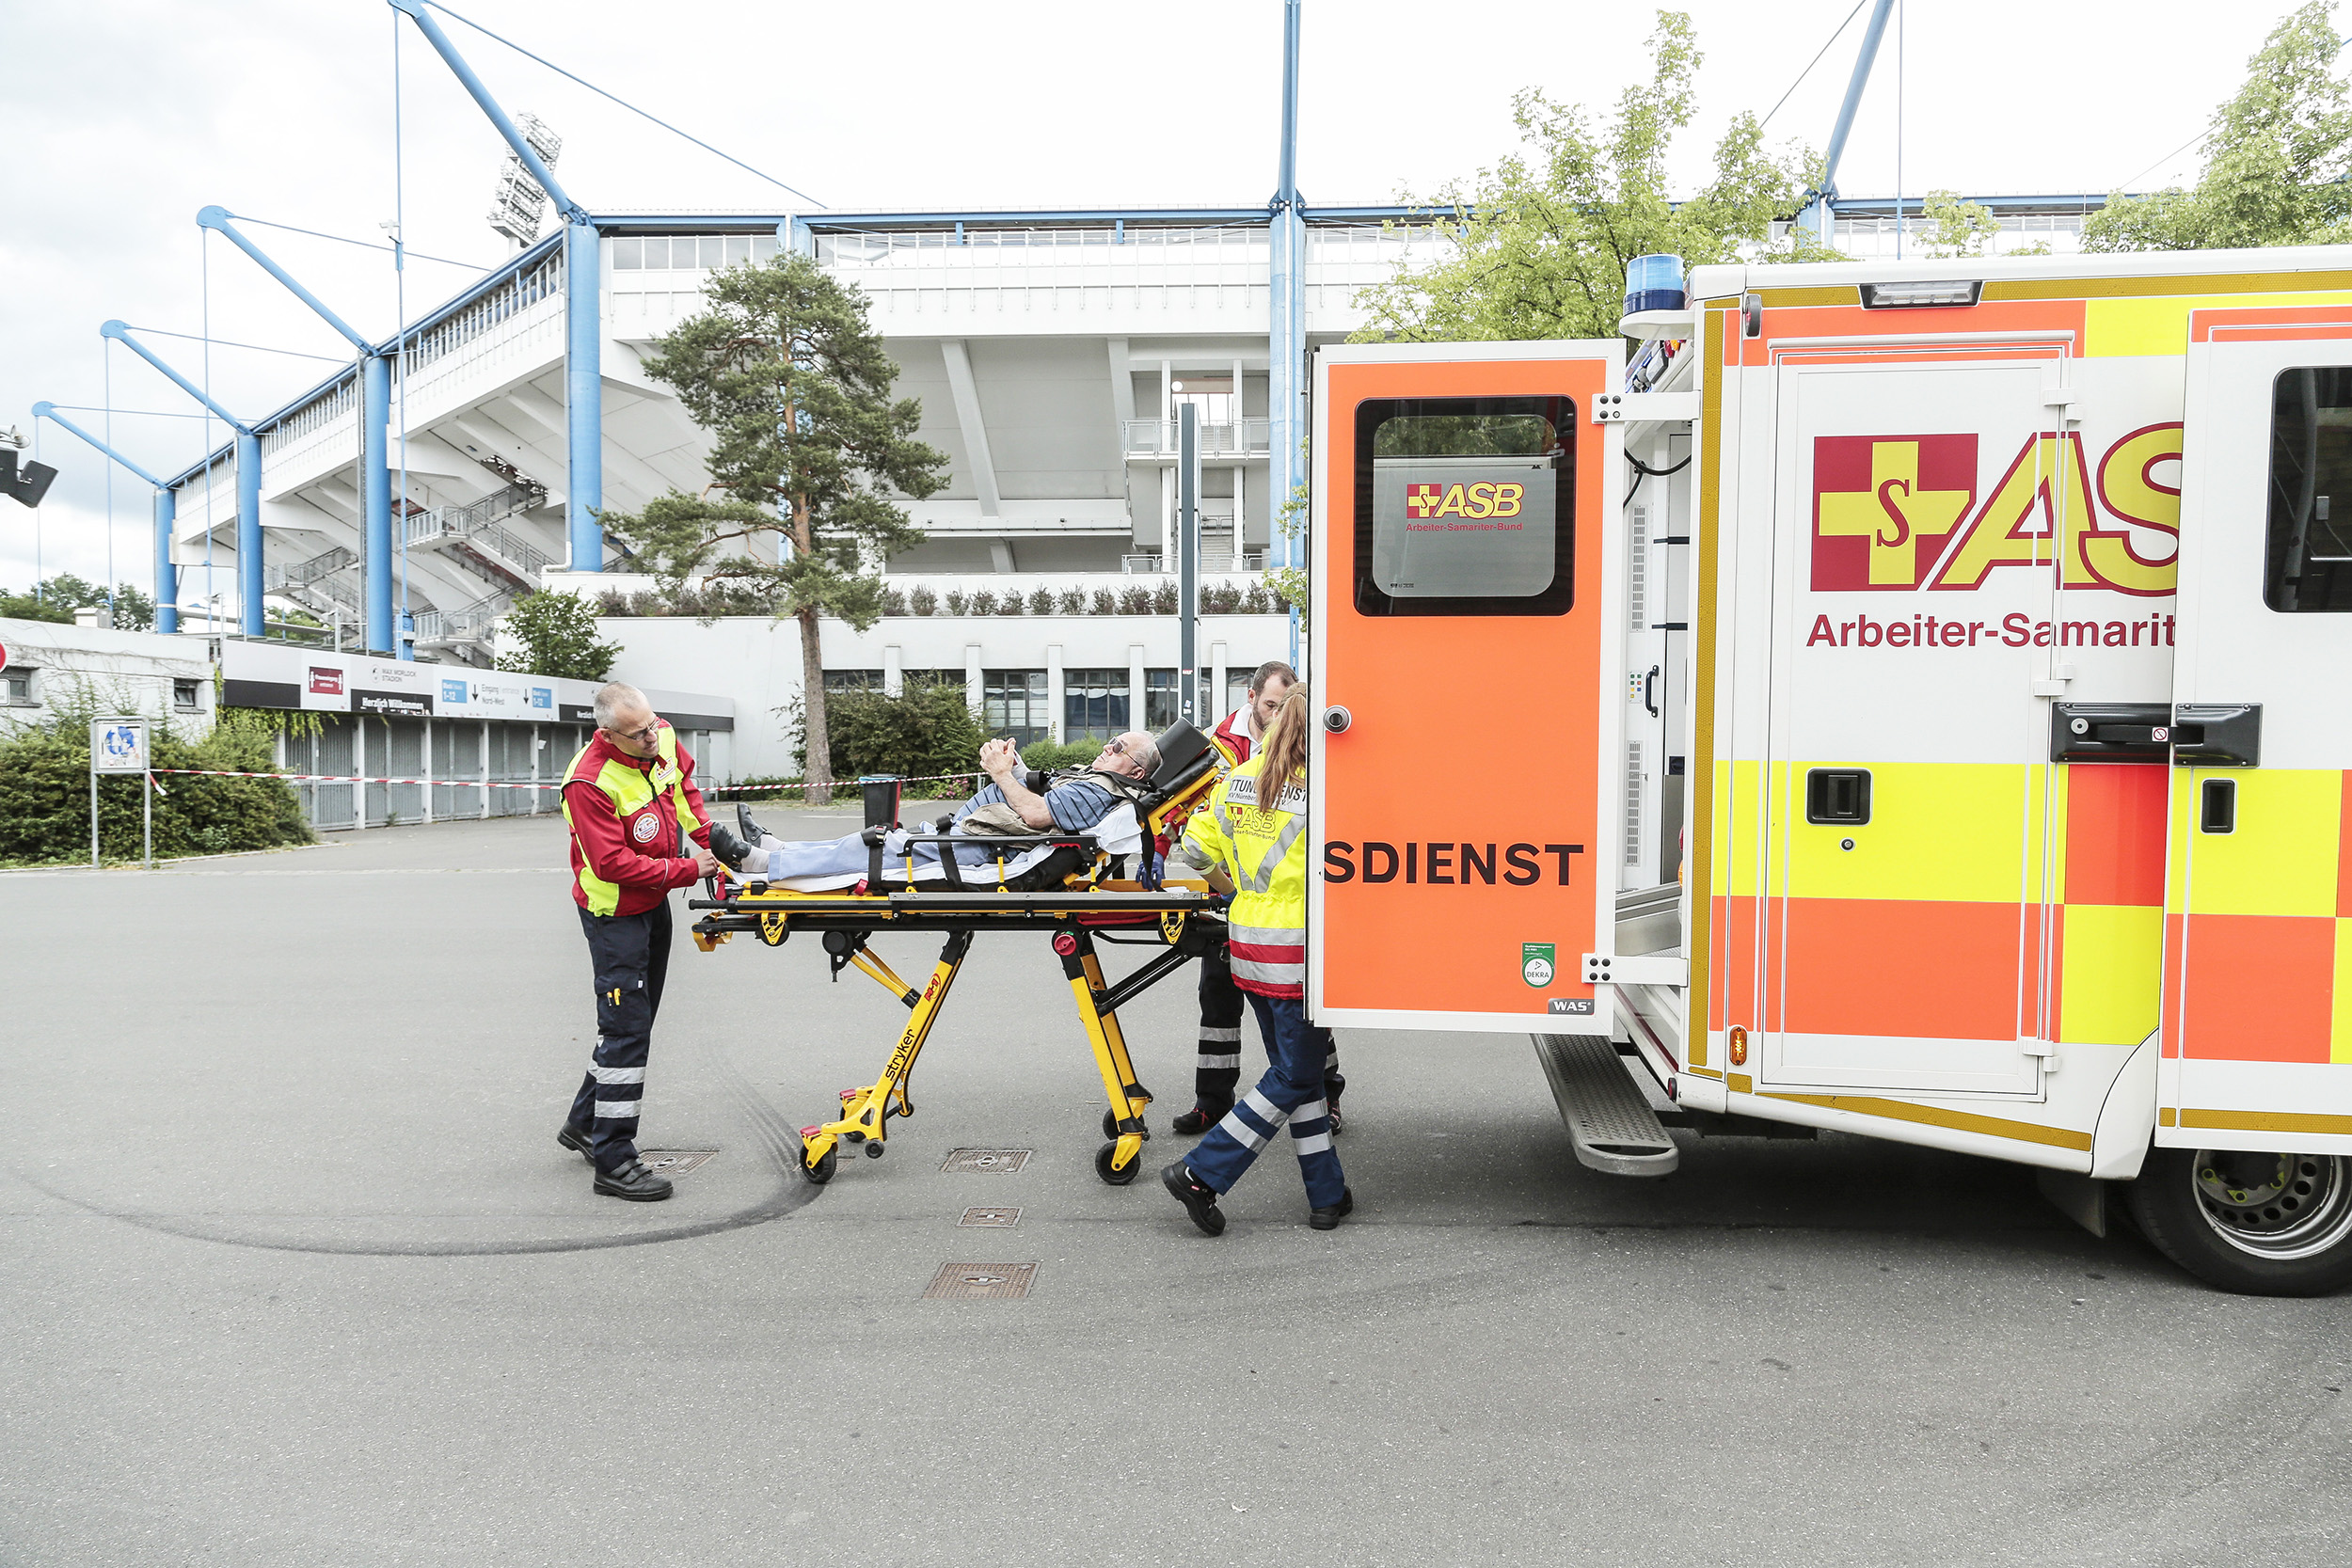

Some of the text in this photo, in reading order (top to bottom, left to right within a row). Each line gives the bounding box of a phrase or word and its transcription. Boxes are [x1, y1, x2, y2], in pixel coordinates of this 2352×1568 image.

[1434, 481, 1525, 519] ASB
[1406, 522, 1523, 531] Arbeiter-Samariter-Bund
[362, 697, 388, 707] Herzlich
[443, 690, 456, 701] 1-12
[1237, 806, 1276, 833] ASB
[1324, 840, 1584, 886] SDIENST
[885, 1028, 915, 1082] stryker
